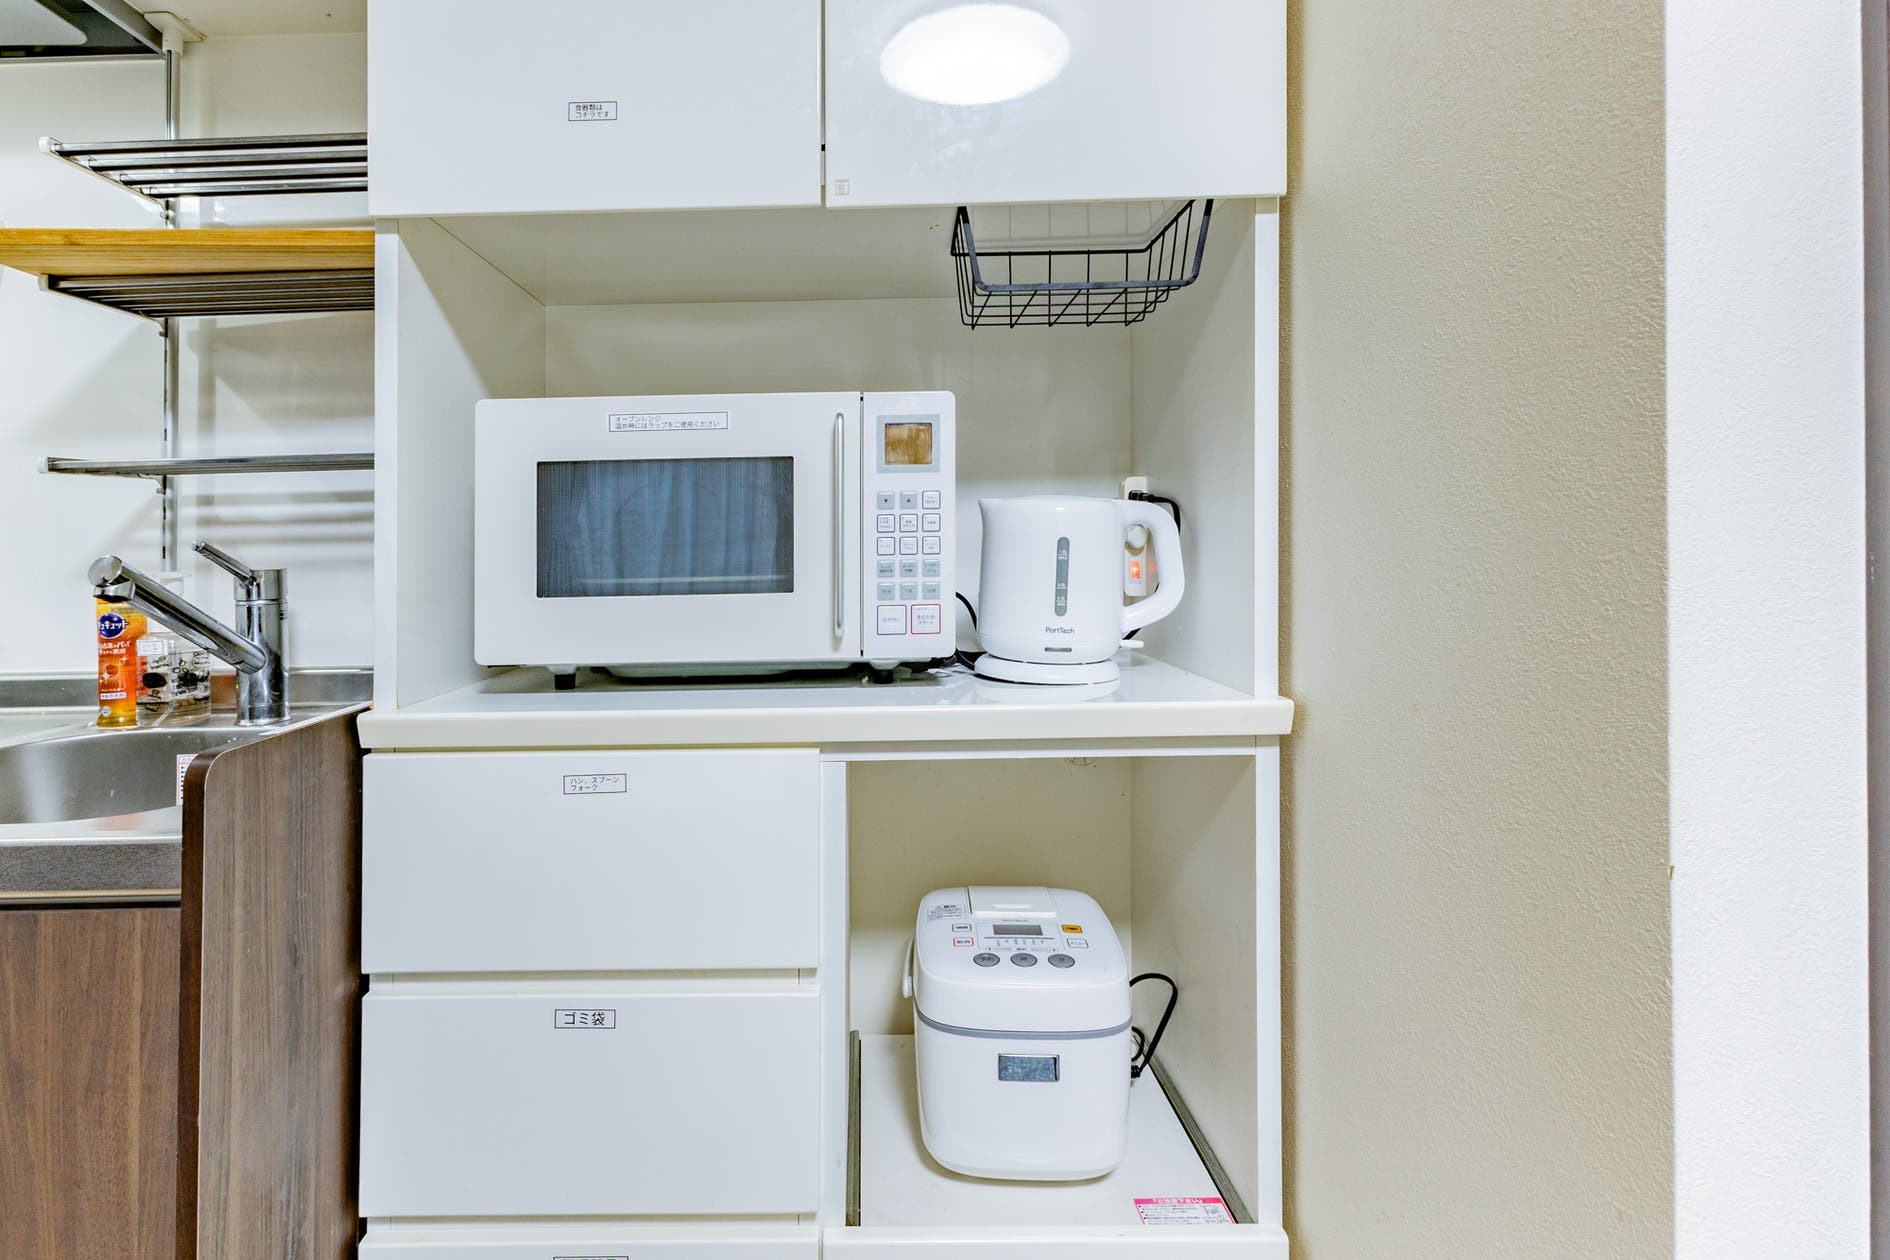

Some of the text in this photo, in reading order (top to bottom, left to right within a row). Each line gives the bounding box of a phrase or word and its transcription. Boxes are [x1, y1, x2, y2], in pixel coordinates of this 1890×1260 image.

[1045, 626, 1075, 634] PortTech
[564, 1011, 606, 1026] ゴミ袋
